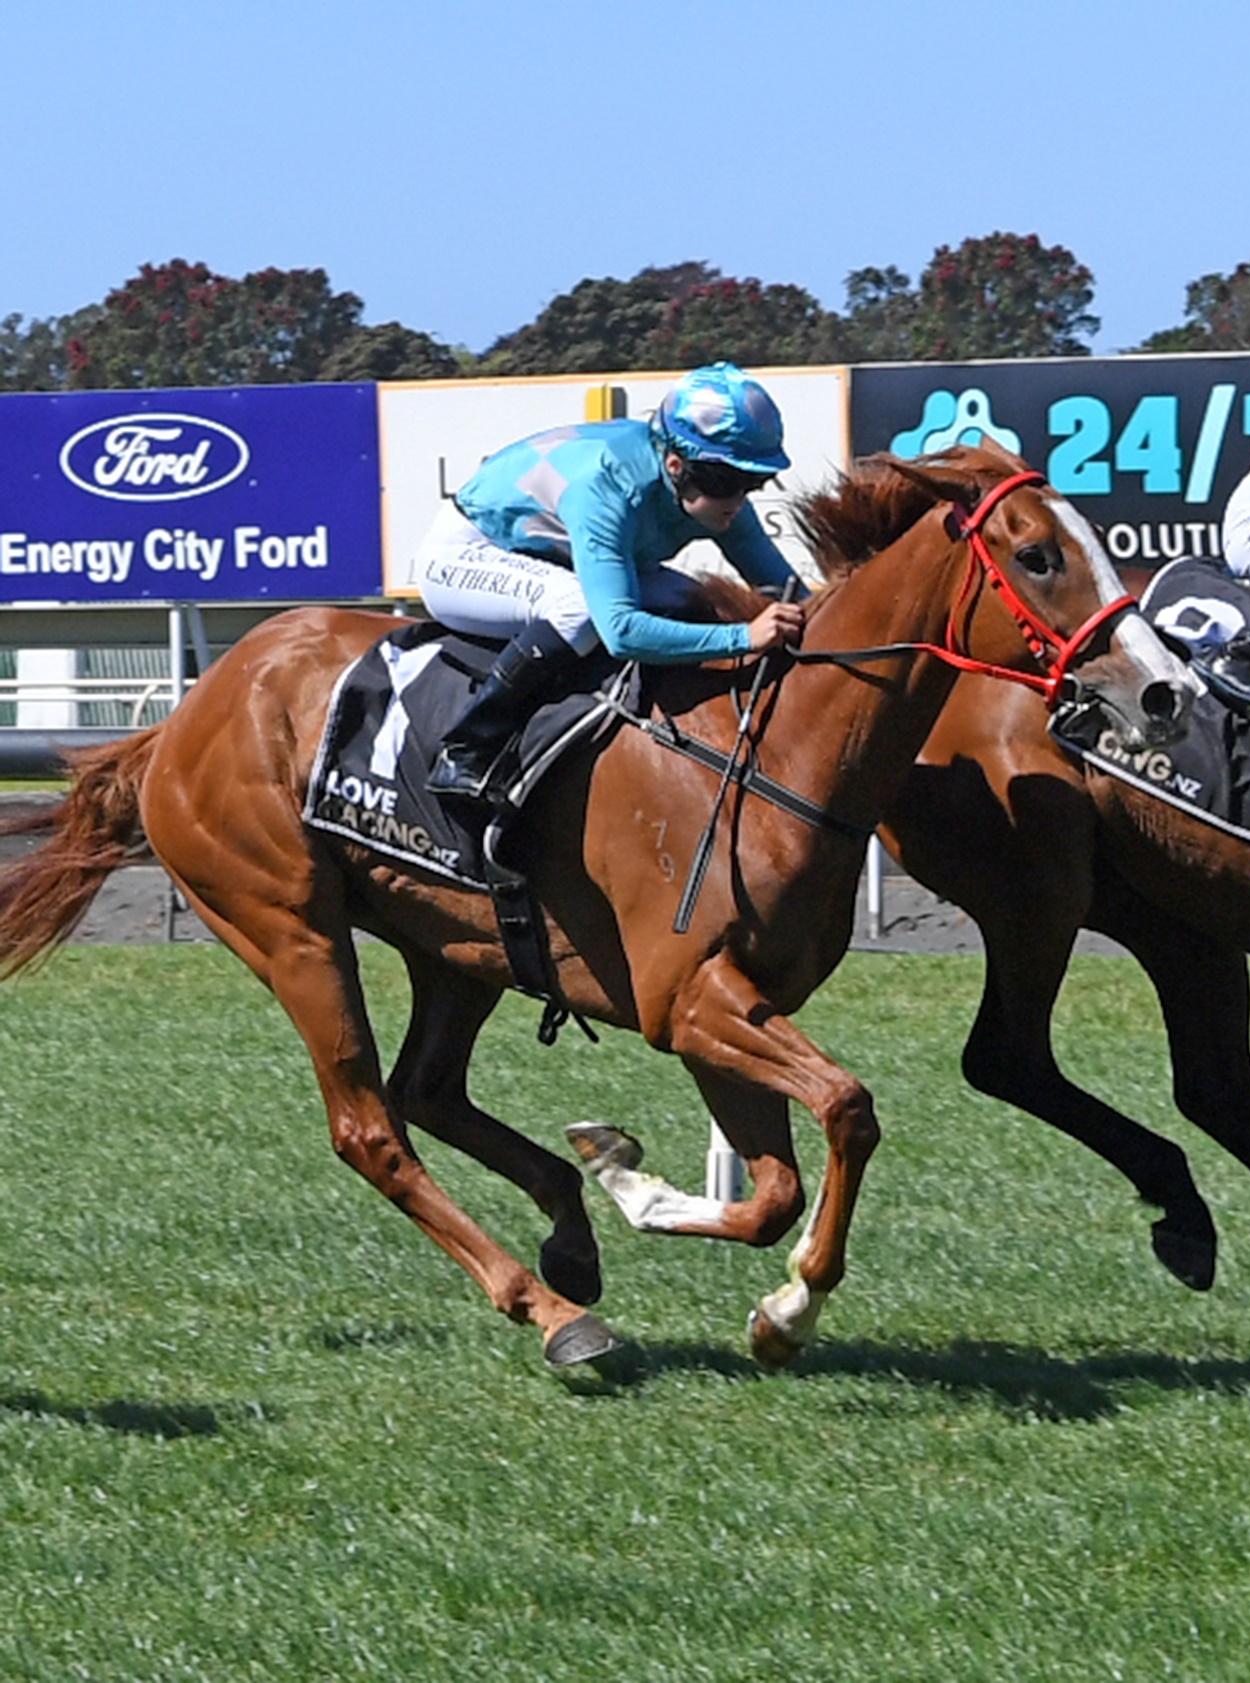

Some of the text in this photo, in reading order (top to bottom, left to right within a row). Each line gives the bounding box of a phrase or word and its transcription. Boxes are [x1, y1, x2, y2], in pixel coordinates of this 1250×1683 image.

[93, 426, 211, 486] Ford
[0, 525, 328, 583] Energy City Ford
[1096, 522, 1221, 559] OLUTI
[326, 770, 399, 816] LOVE
